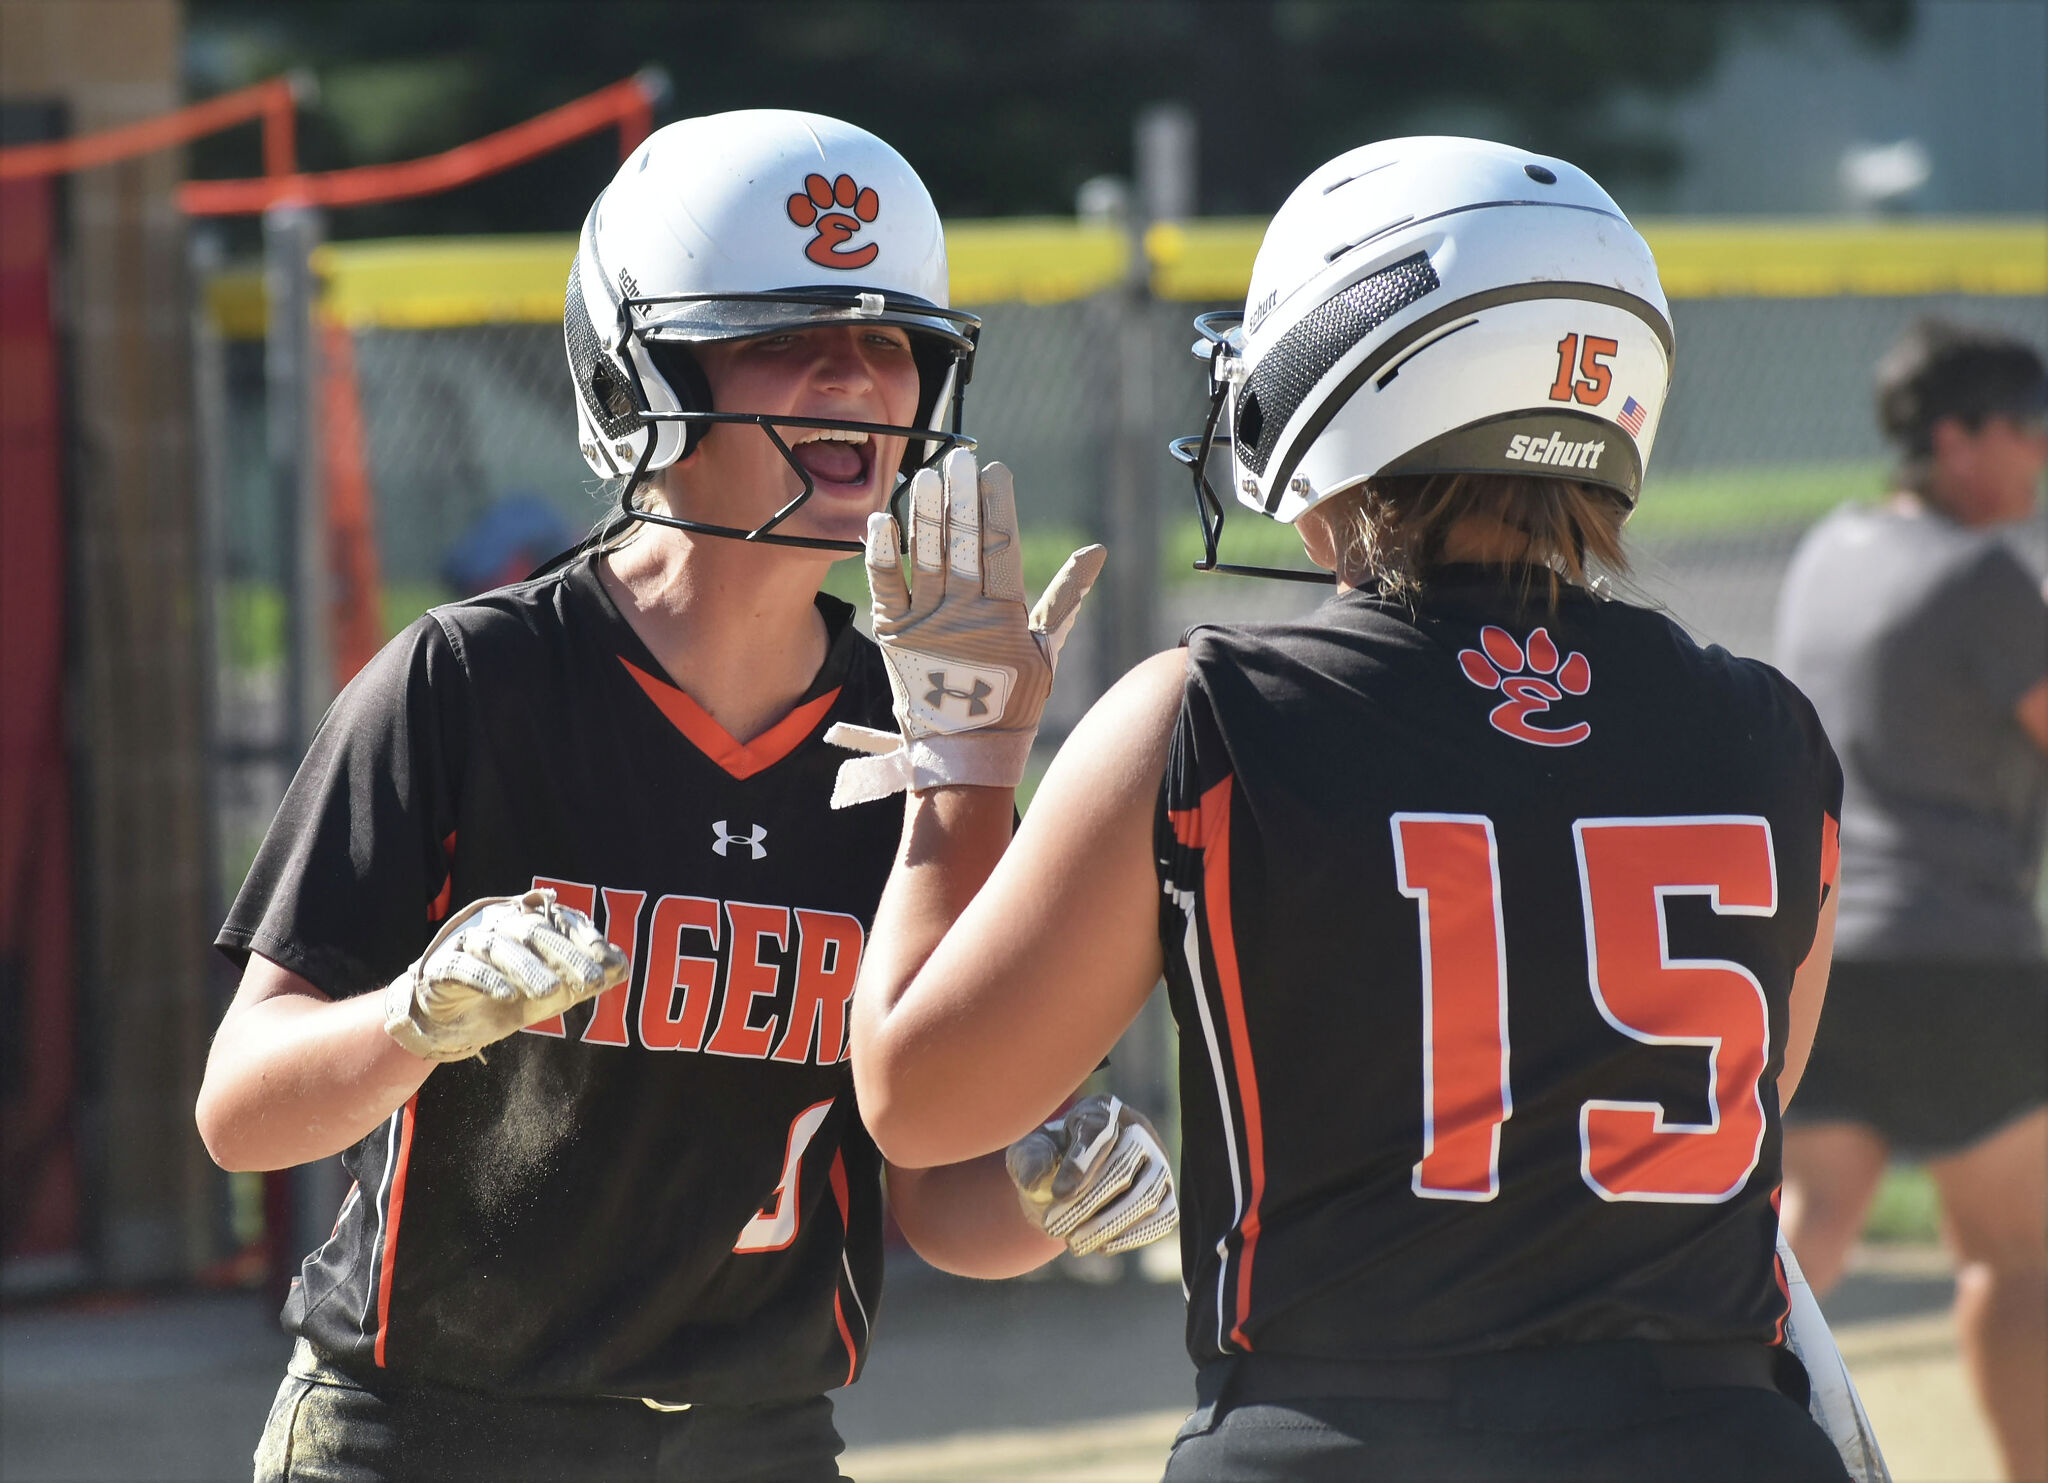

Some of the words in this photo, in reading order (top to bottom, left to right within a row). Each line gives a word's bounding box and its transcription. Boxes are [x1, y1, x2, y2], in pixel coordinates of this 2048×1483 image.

[1249, 289, 1278, 333] schutt
[1549, 333, 1618, 406] 15
[1505, 431, 1605, 469] schutt
[519, 876, 864, 1065] IGER
[1389, 812, 1778, 1203] 15
